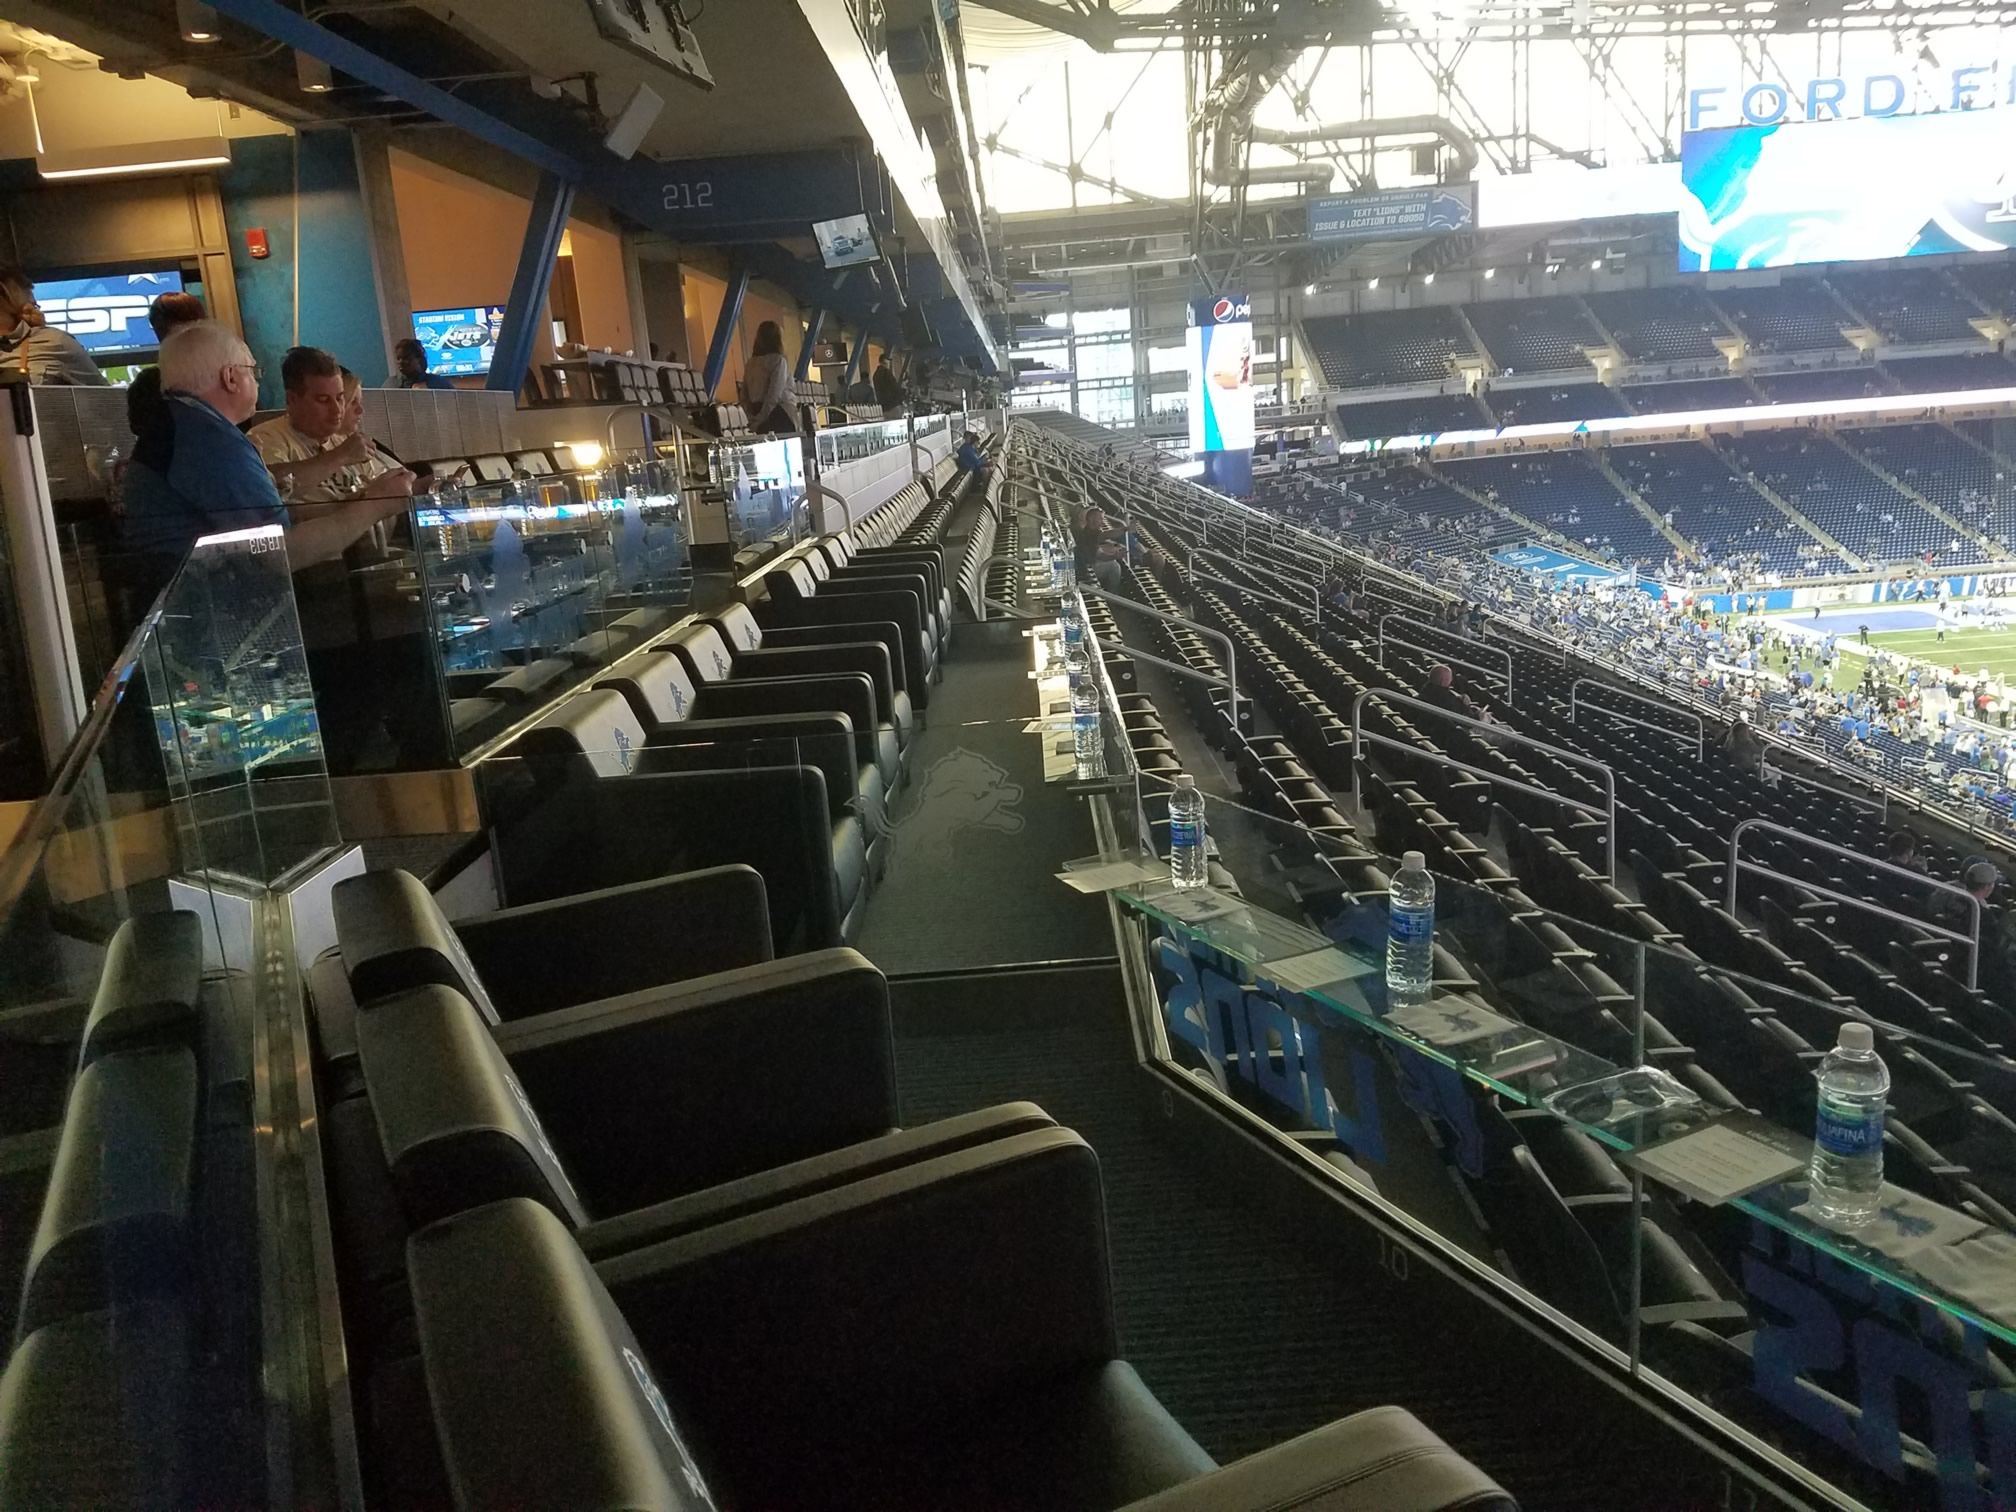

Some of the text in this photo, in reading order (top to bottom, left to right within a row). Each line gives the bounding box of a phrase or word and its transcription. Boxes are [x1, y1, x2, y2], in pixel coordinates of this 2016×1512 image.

[1689, 74, 1905, 129] FORD
[661, 181, 713, 210] 212
[1352, 208, 1372, 217] TEXT
[1405, 203, 1427, 213] WITH
[1314, 220, 1339, 231] ISSUE
[1346, 217, 1385, 228] LOCATION
[1386, 215, 1396, 224] TO
[36, 294, 158, 335] ESP
[449, 331, 482, 341] JETS
[1376, 1233, 1408, 1281] 10
